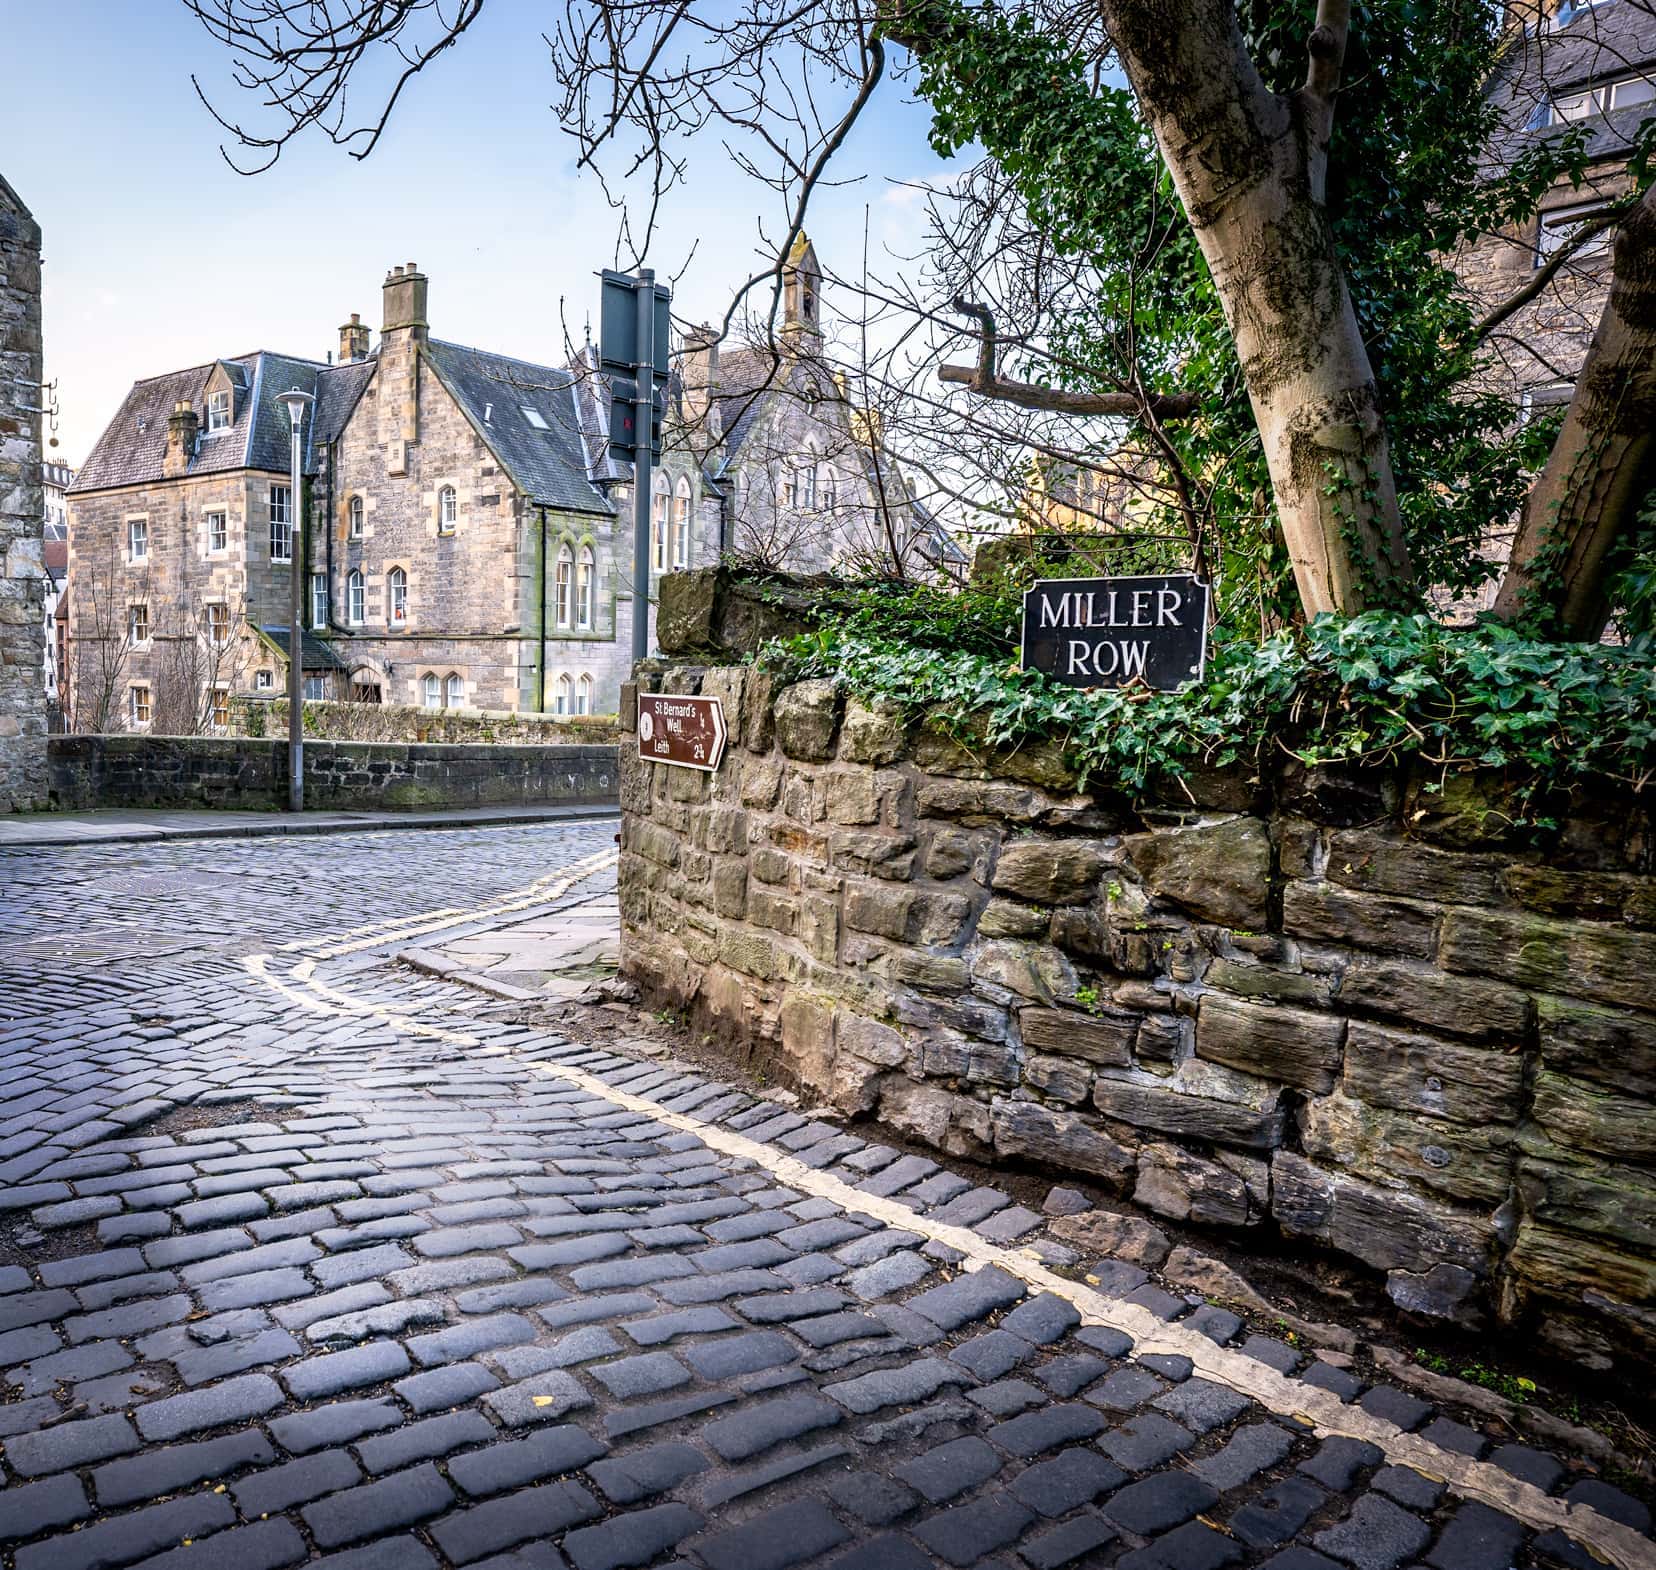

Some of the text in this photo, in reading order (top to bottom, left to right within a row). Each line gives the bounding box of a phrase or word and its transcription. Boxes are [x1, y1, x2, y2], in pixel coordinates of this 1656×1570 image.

[1039, 590, 1183, 628] MILLER
[1066, 640, 1151, 676] ROW
[654, 701, 663, 714] St
[666, 718, 682, 733] Well
[654, 739, 670, 754] Leith
